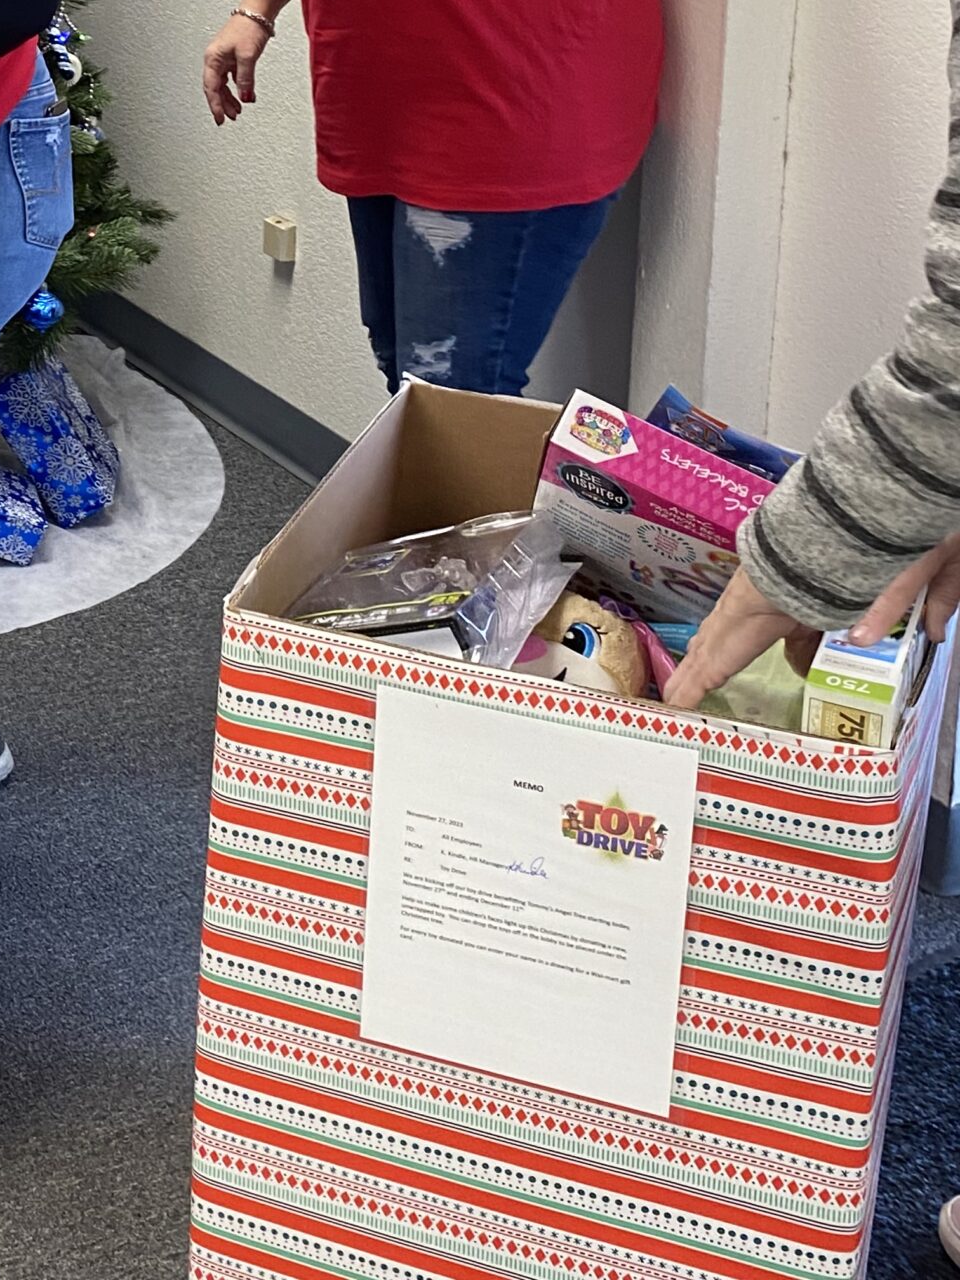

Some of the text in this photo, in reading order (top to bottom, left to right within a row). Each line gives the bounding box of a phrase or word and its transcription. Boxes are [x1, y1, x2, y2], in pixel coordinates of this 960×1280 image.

[578, 469, 602, 487] BE
[659, 448, 749, 498] BRACELETS
[825, 675, 872, 695] 750
[513, 779, 545, 793] MEMO
[576, 799, 656, 841] TOY
[576, 830, 649, 860] DRIVE
